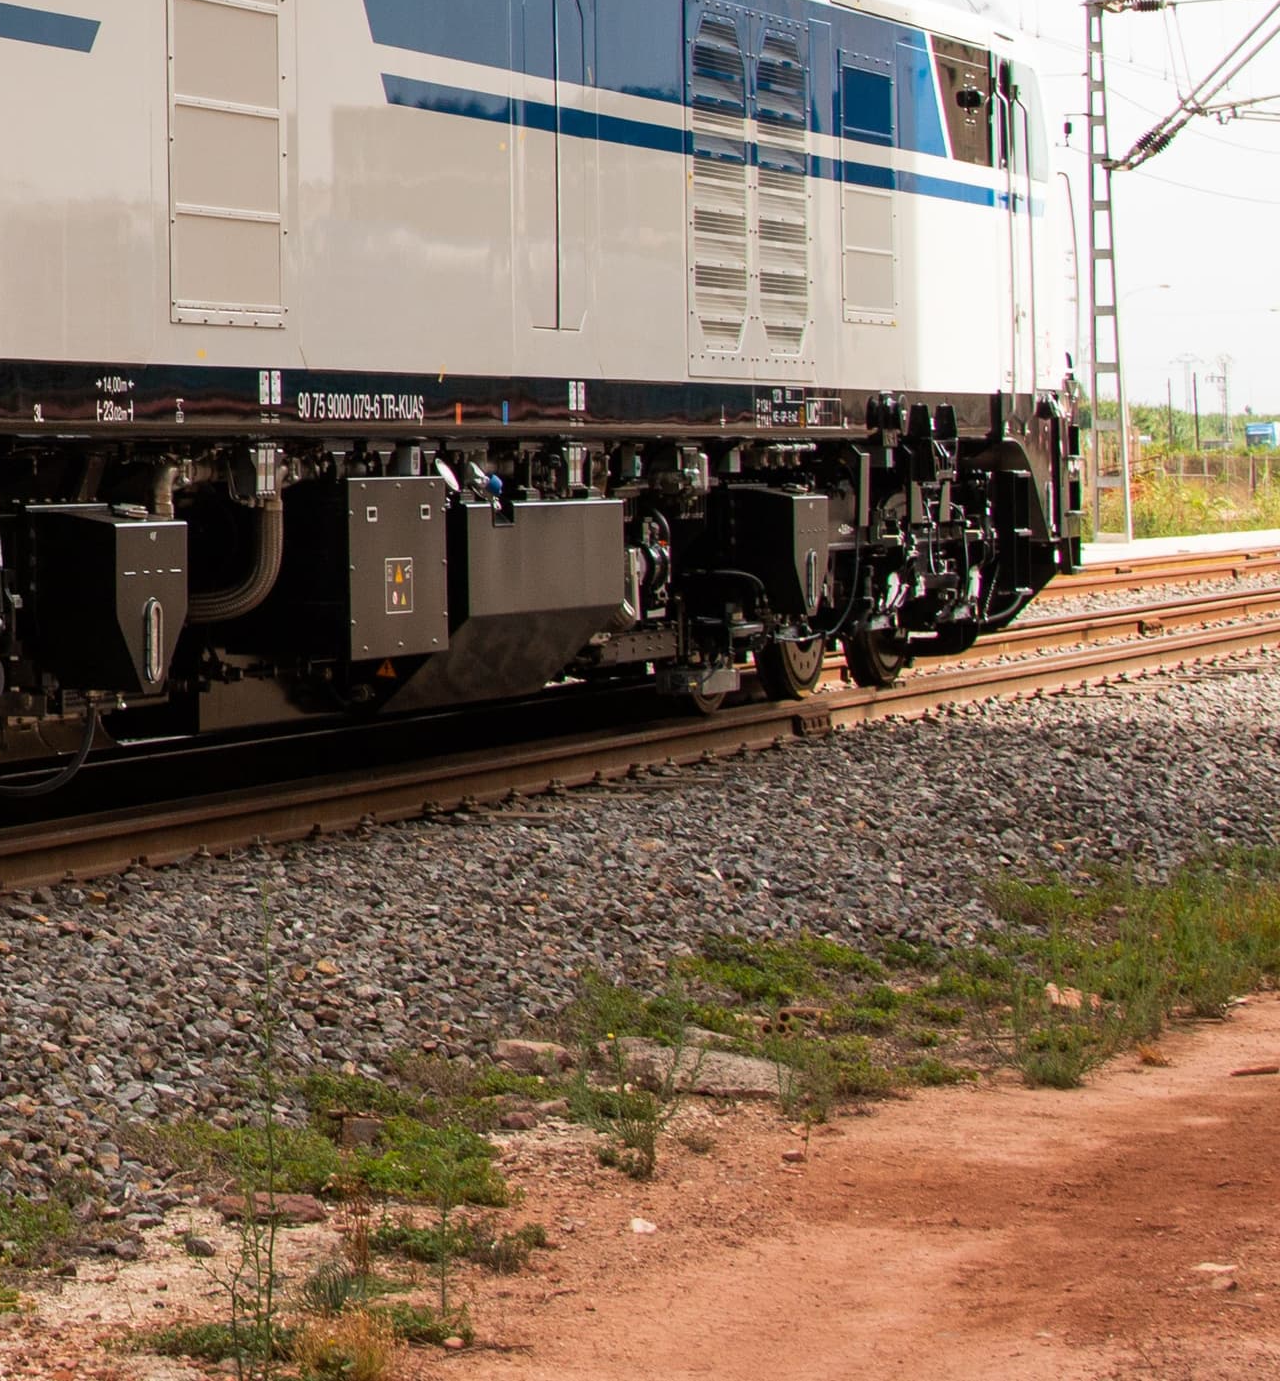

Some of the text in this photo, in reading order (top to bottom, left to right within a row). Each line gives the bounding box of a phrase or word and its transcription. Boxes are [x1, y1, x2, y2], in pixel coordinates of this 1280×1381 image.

[33, 403, 45, 422] 3L
[298, 392, 311, 419] 90
[312, 393, 326, 419] 75
[327, 393, 352, 420] 9000
[353, 394, 380, 420] 079-6
